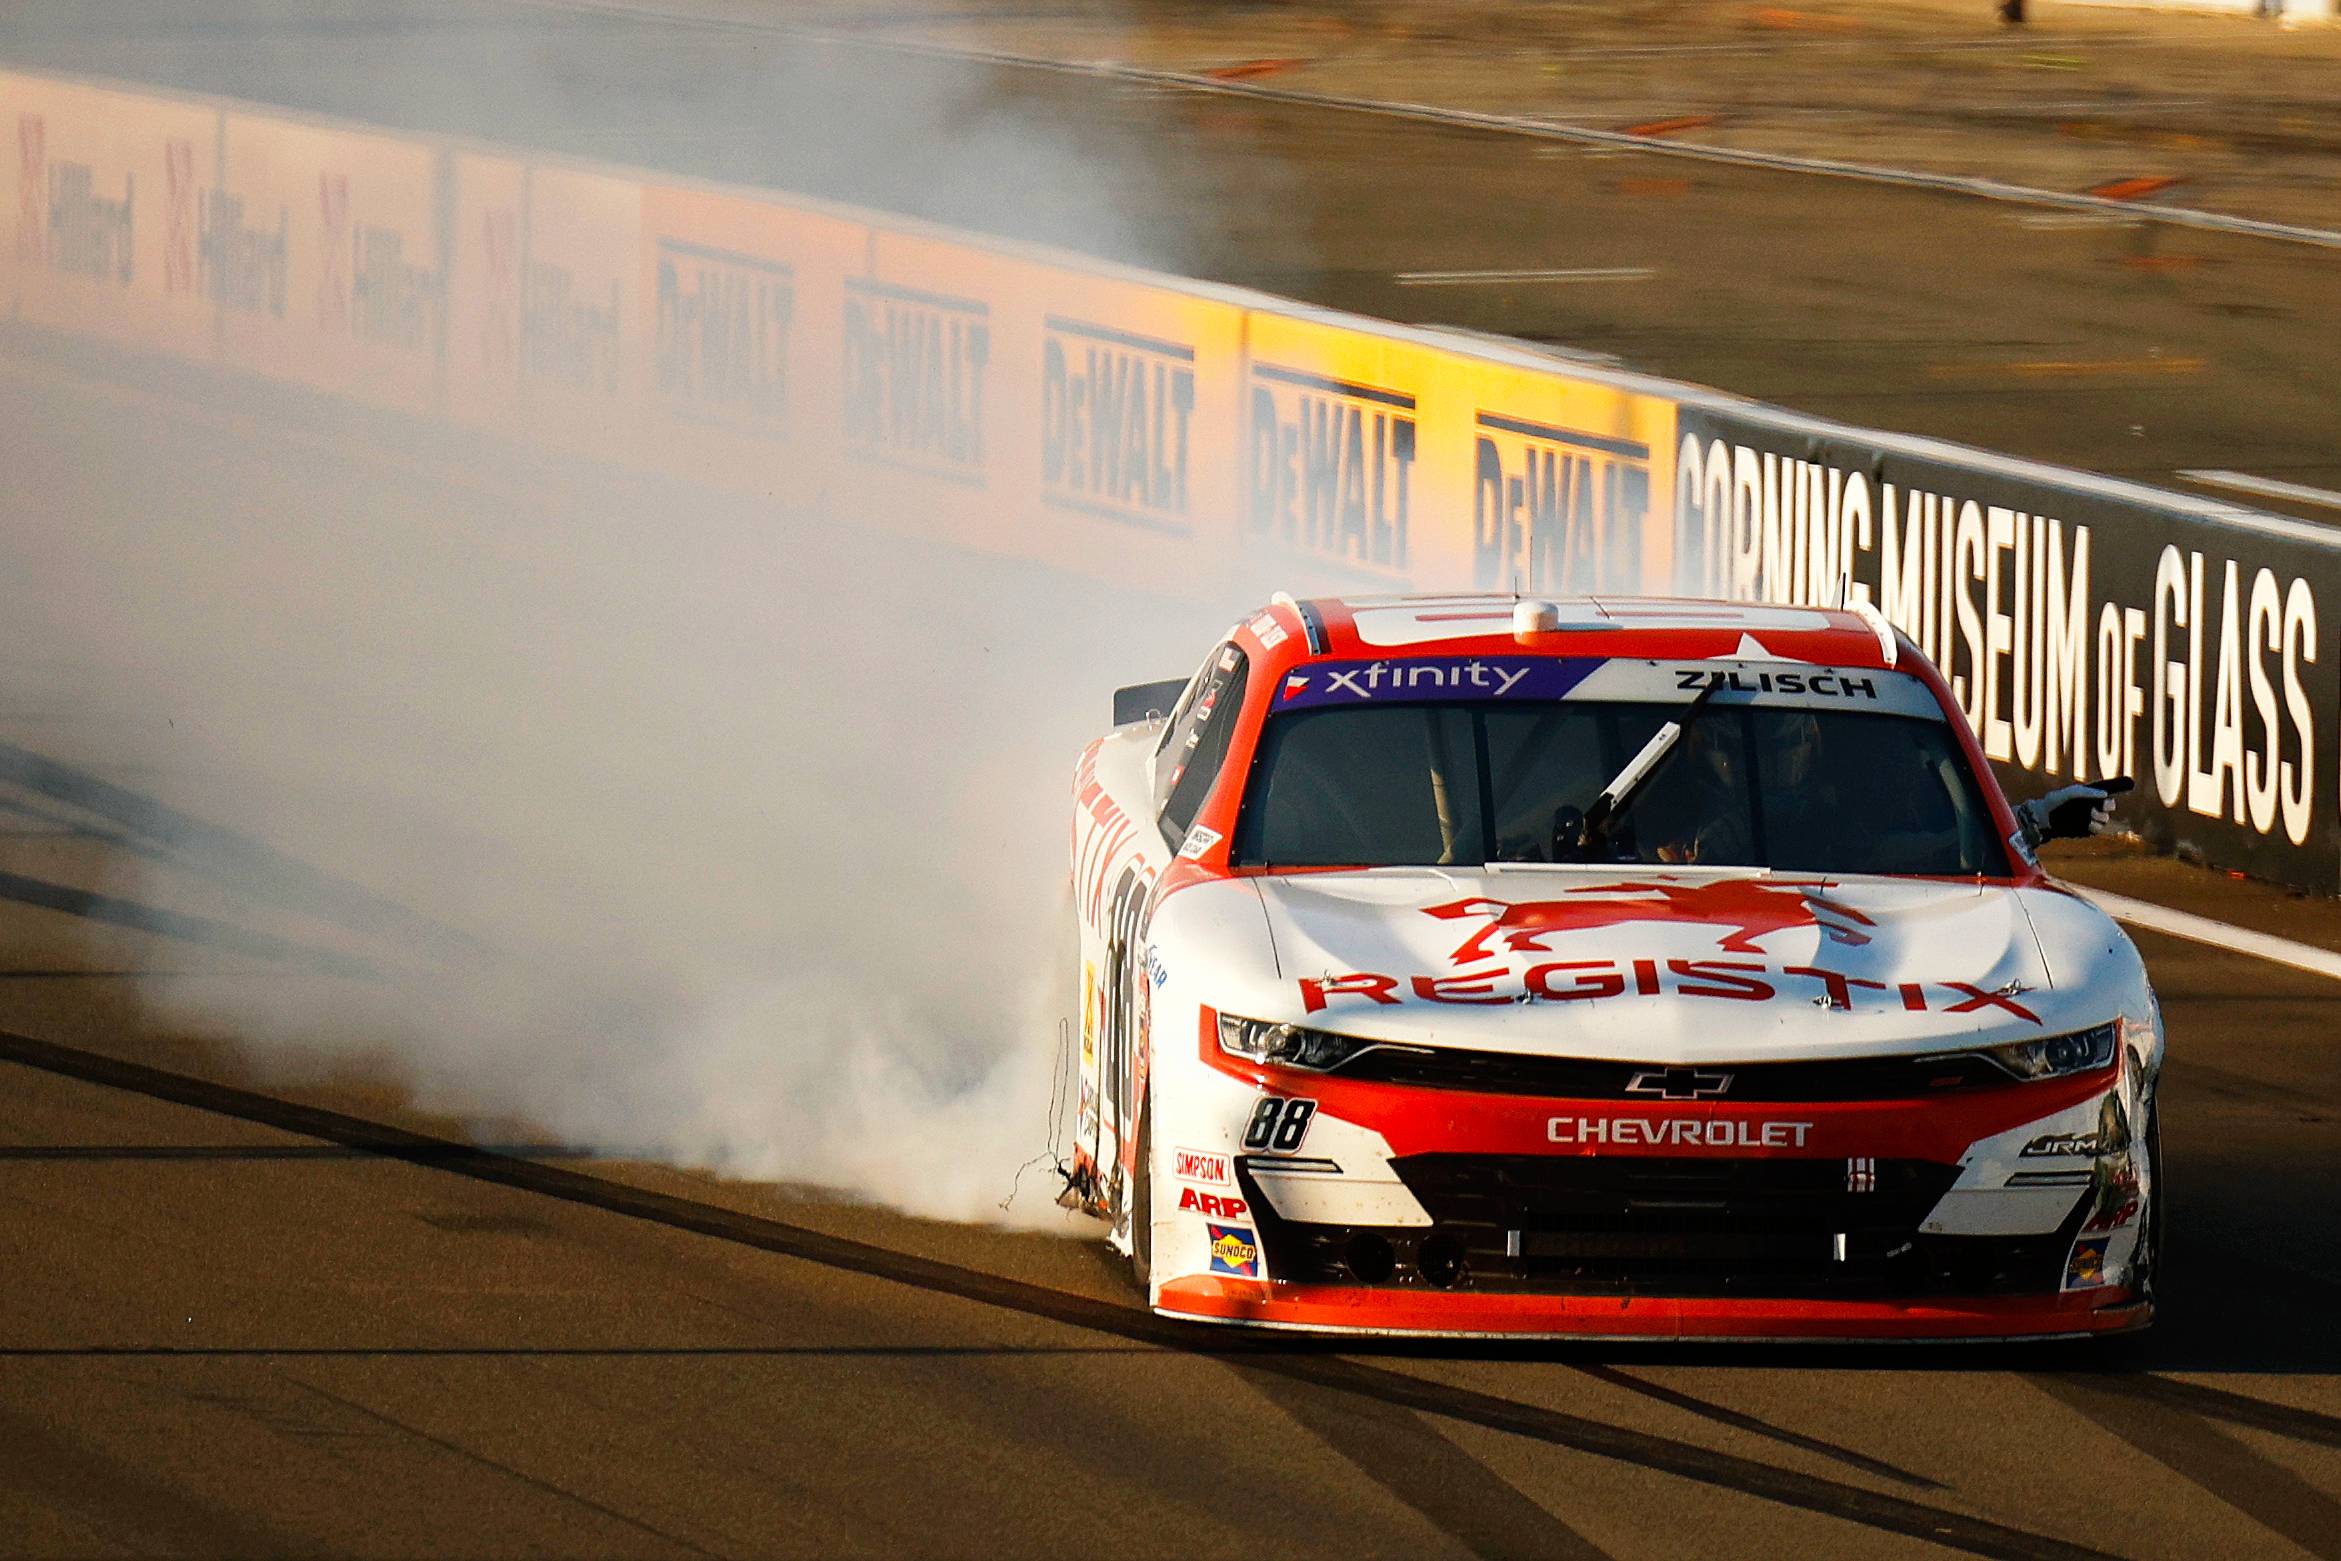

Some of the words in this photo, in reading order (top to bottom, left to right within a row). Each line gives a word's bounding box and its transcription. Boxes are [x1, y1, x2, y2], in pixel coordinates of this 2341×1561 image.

[1676, 432, 1873, 608] CORNING
[1879, 482, 2090, 782] MUSEUM
[2097, 601, 2146, 781] OF
[2153, 543, 2318, 846] GLASS
[1325, 660, 1531, 698] xfinity
[1676, 669, 1877, 700] ZILISCH
[1298, 958, 2043, 1027] REGISTIX
[1243, 1096, 1318, 1152] 88
[1547, 1116, 1815, 1148] CHEVROLET
[1176, 1152, 1225, 1182] SIMPSON
[1178, 1187, 1248, 1219] ARP
[1213, 1241, 1256, 1262] SUNOCO
